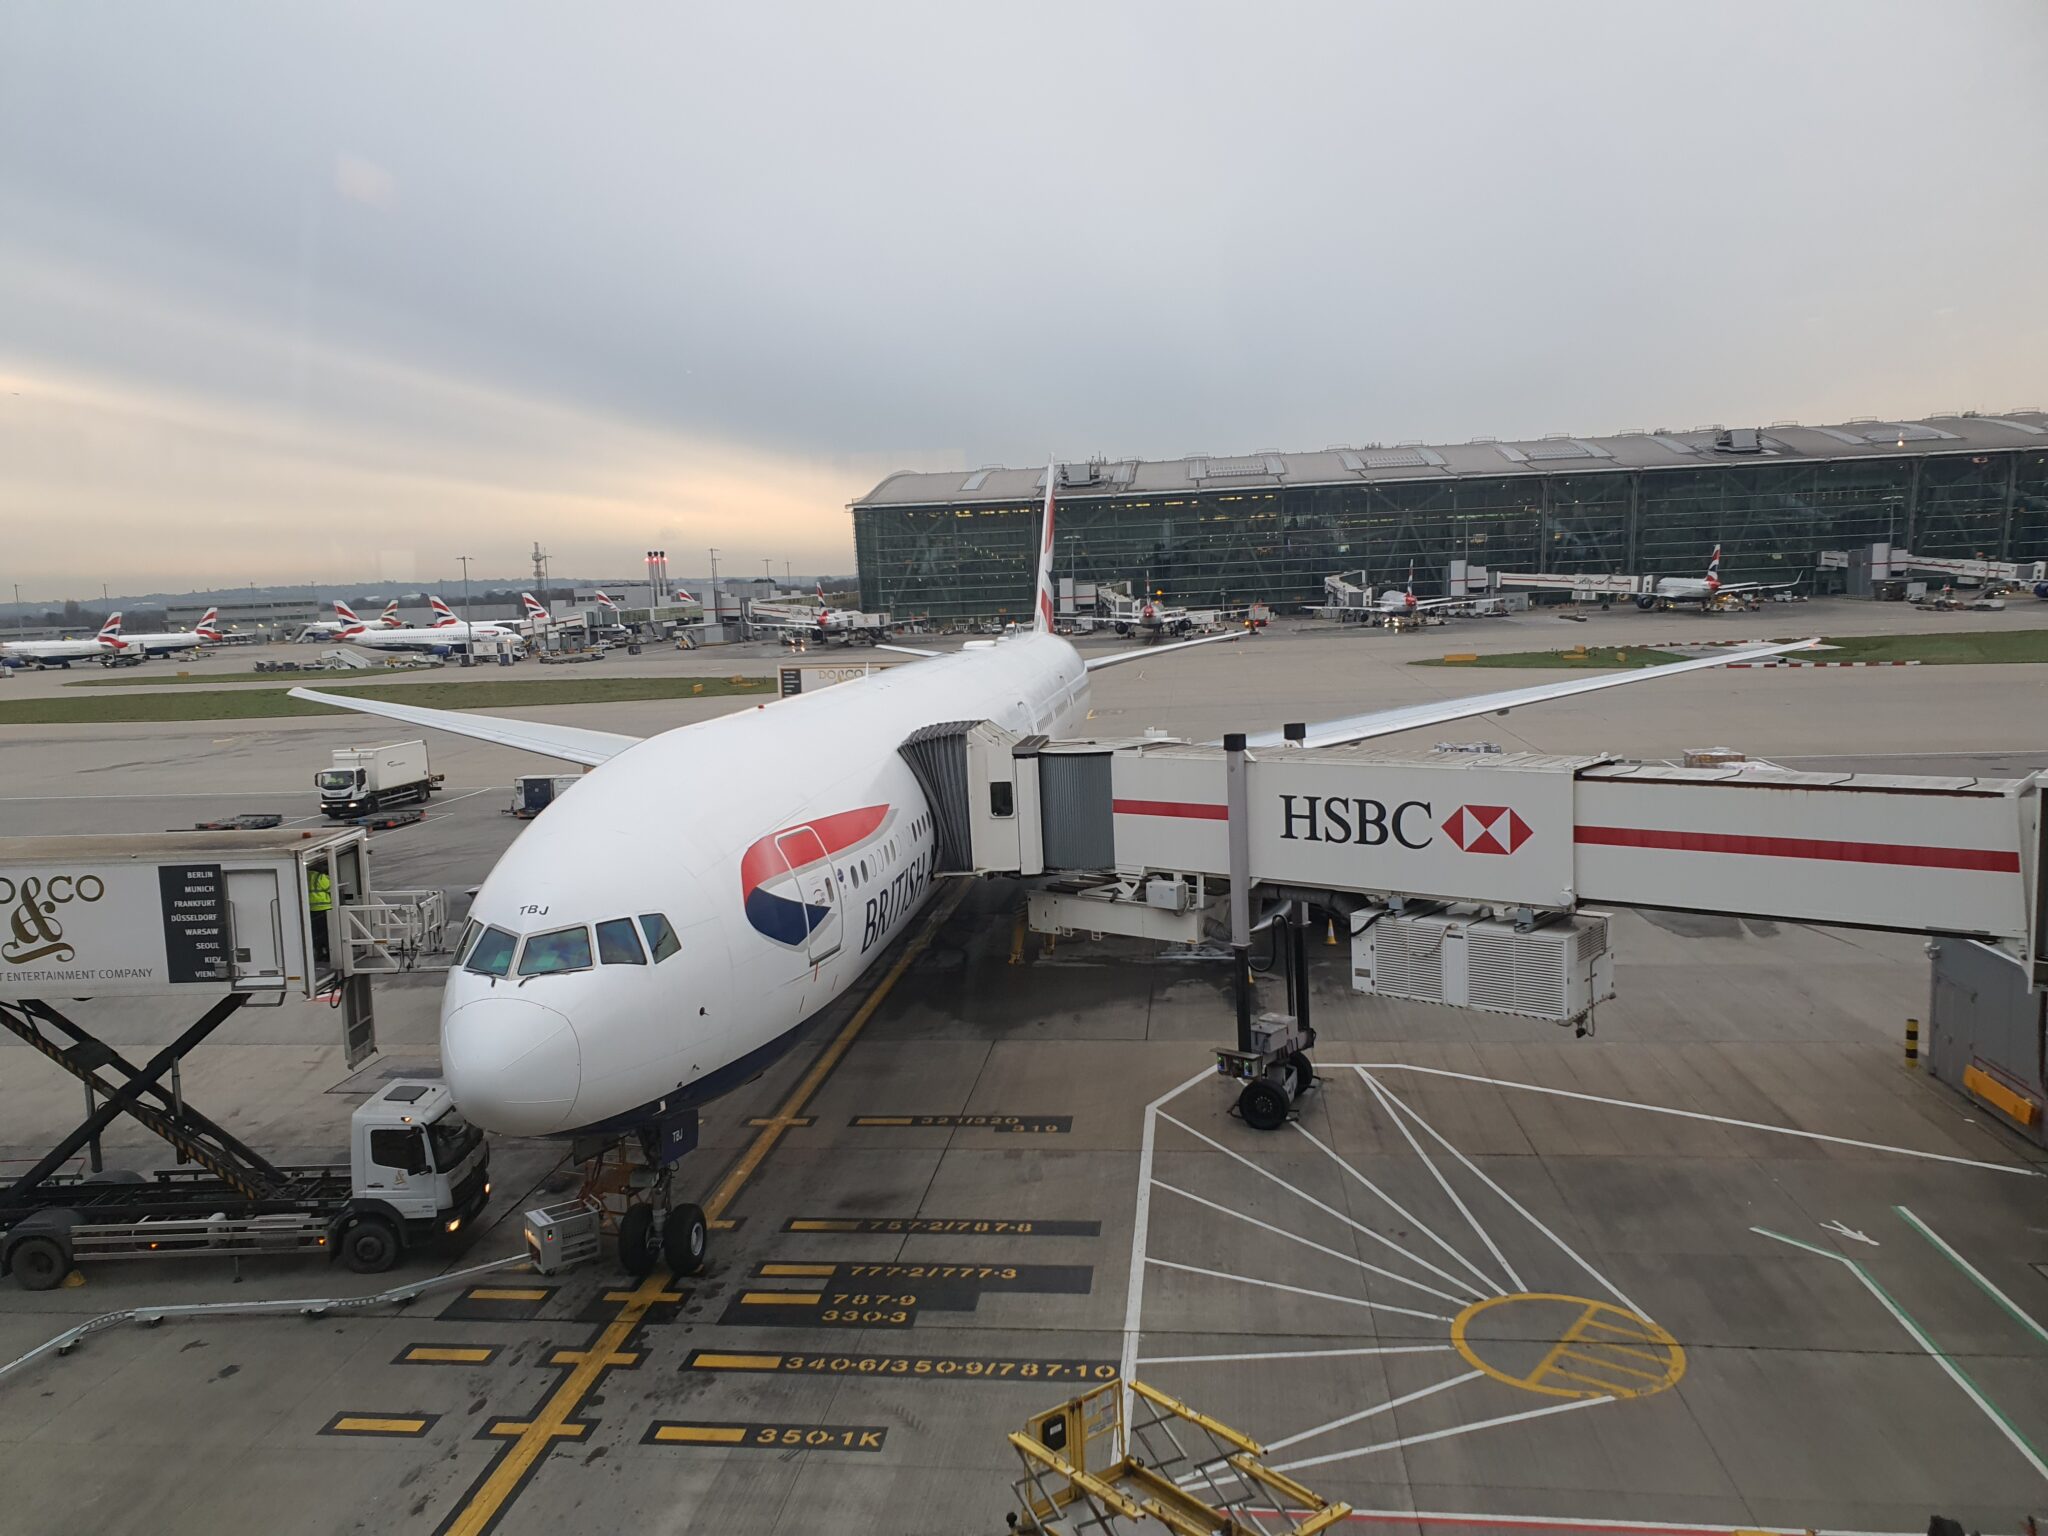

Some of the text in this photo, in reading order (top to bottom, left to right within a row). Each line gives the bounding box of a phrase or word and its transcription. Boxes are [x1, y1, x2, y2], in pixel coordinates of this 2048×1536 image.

[1279, 795, 1433, 849] HSBC
[187, 871, 213, 879] BERLIN
[184, 885, 215, 893] MUNICH
[174, 900, 216, 908] FRANKFURT
[861, 851, 926, 954] BRITISH
[519, 904, 549, 916] TBJ
[171, 913, 217, 922] DÜSSELDORF
[185, 928, 219, 936] WARSAW
[195, 942, 220, 950] SEOUL
[204, 956, 222, 964] KIEV
[7, 970, 95, 982] ENTERTAINMENT
[98, 968, 153, 979] COMPANY
[194, 970, 216, 978] VIEN
